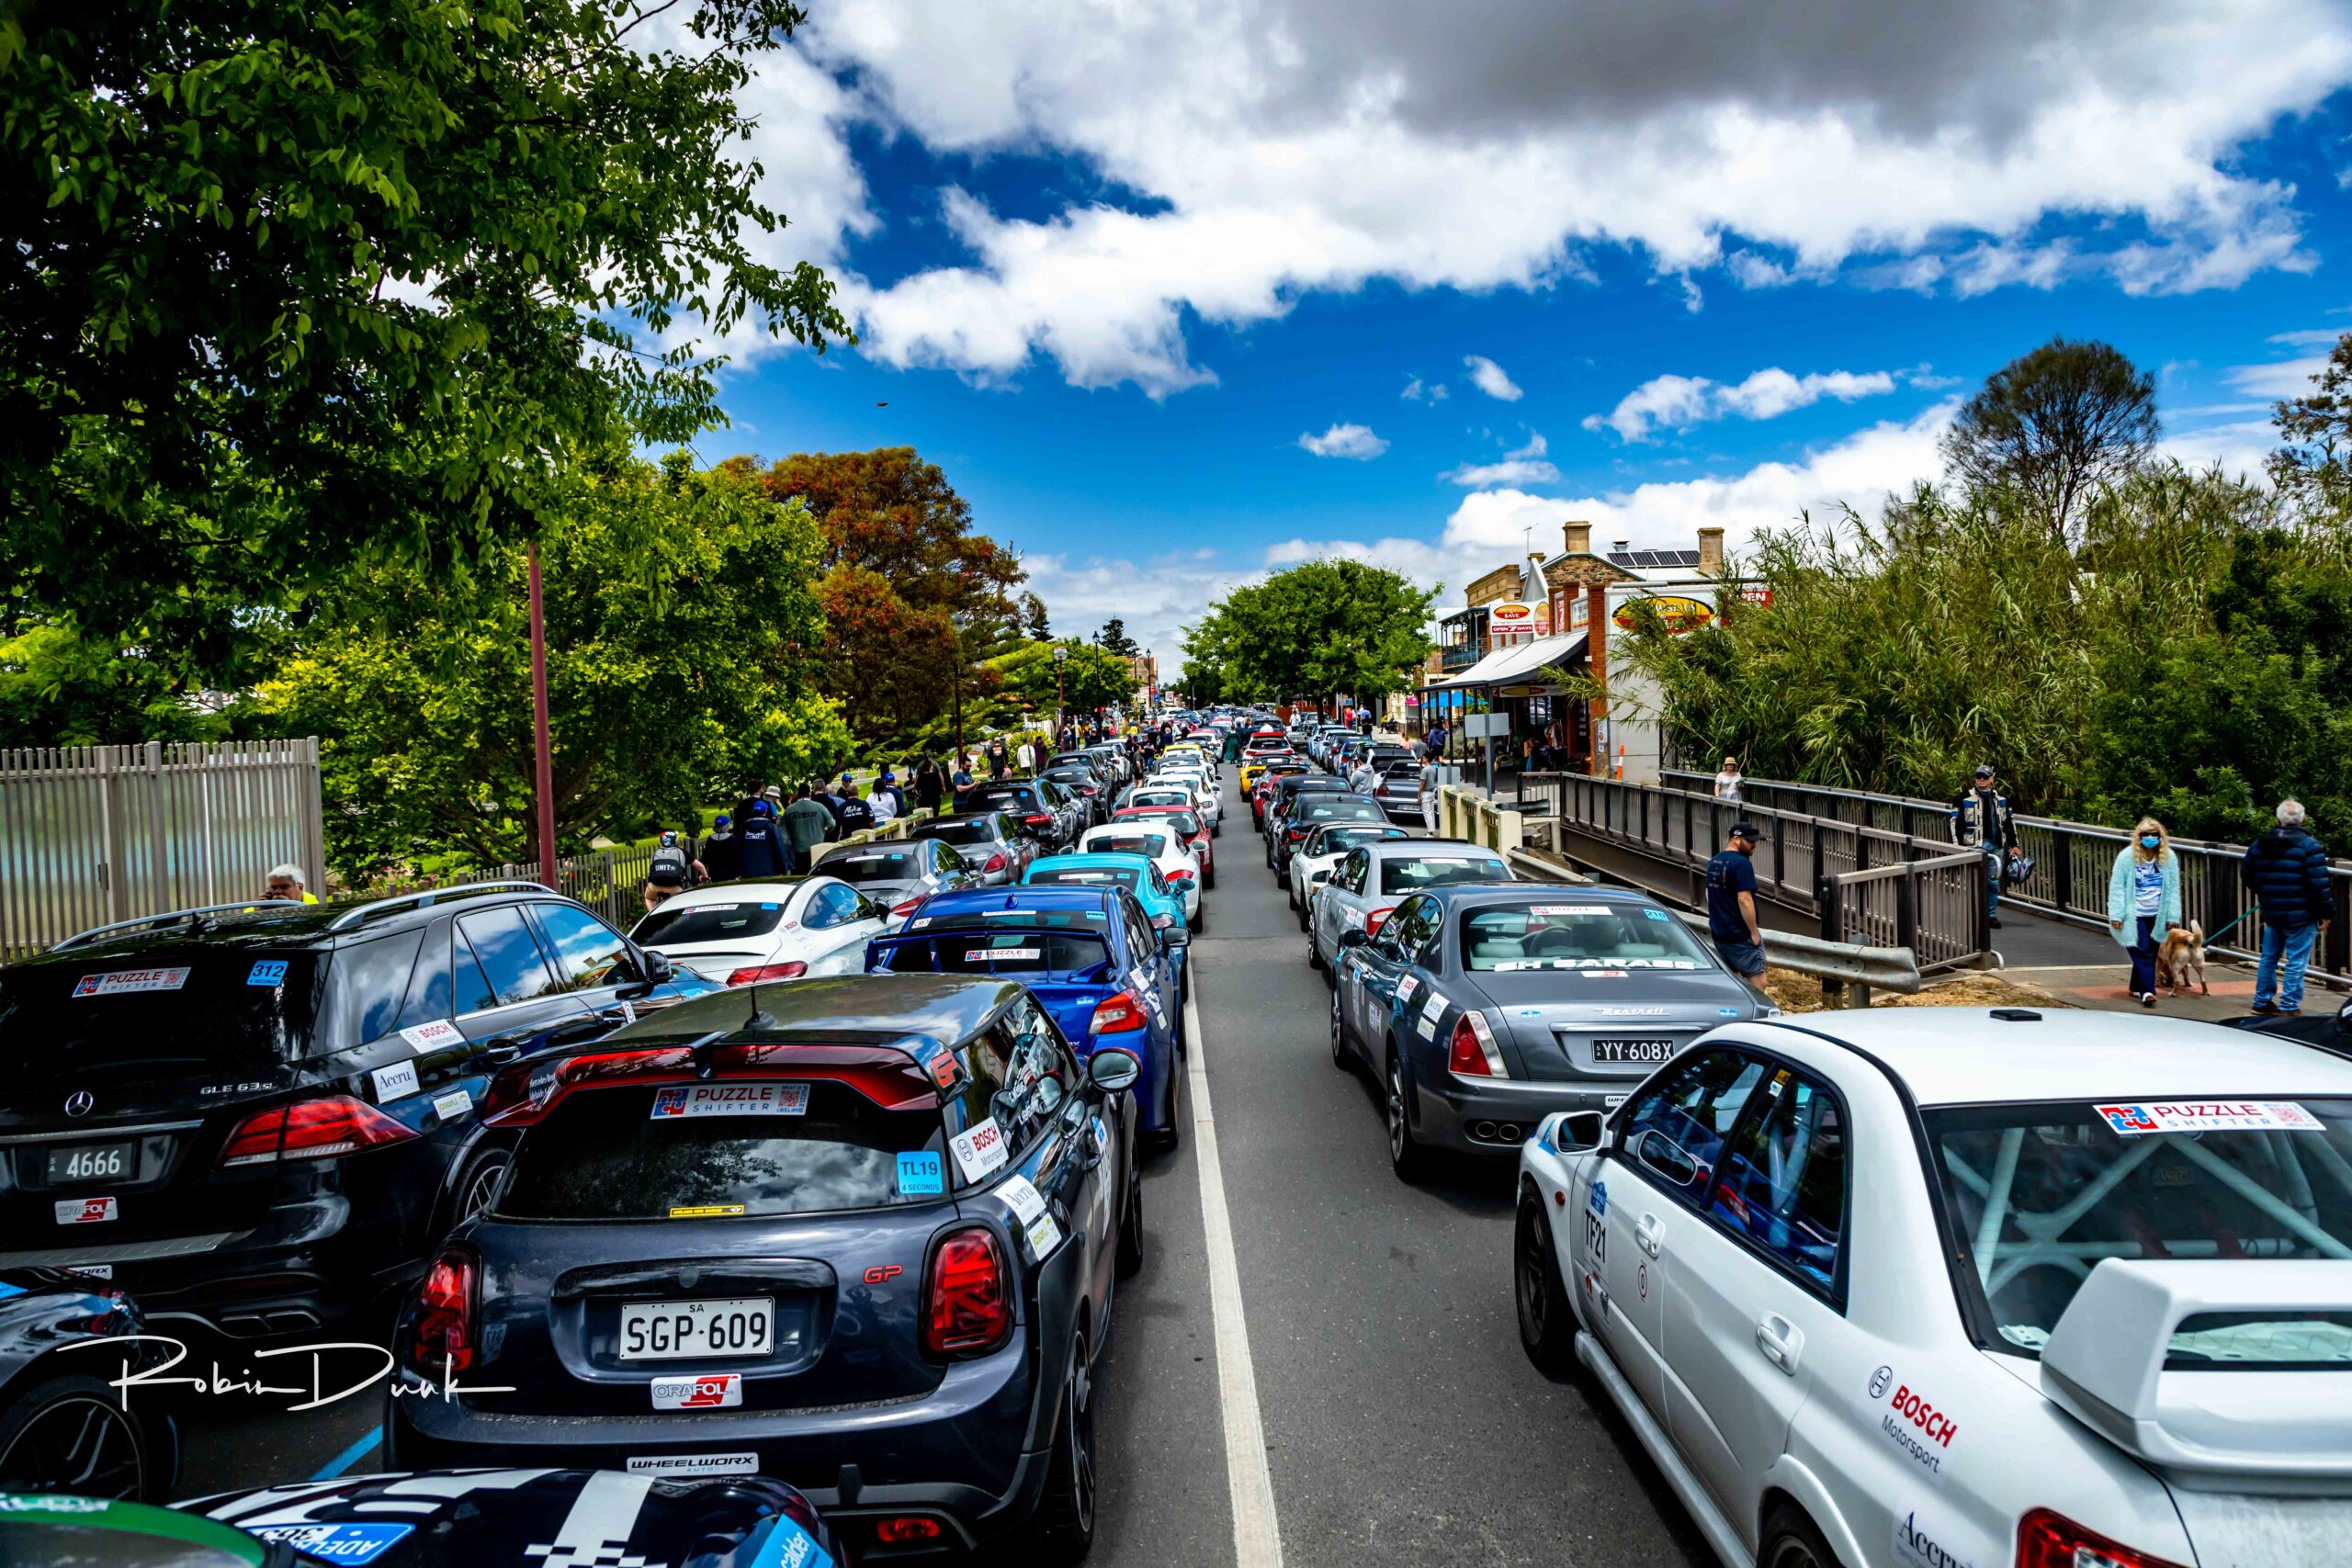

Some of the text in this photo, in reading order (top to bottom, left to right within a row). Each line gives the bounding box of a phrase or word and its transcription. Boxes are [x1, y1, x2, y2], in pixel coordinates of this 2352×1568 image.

[106, 971, 164, 984] PUZZLE
[252, 964, 285, 977] 312
[103, 982, 158, 992] SHIFTER
[419, 1023, 451, 1038] BOSCH
[379, 1070, 413, 1090] Accru
[200, 1085, 233, 1094] GLE
[695, 1087, 774, 1102] PUZZLE
[693, 1102, 770, 1112] SHIFTER
[2153, 1104, 2264, 1118] PUZZLE
[2167, 1118, 2272, 1127] SHIFTER
[972, 1124, 1000, 1152] BOSCH
[66, 1150, 121, 1178] 4666
[900, 1162, 938, 1176] TL19
[908, 1183, 940, 1191] SECONDS
[1585, 1208, 1606, 1264] TF21
[864, 1265, 903, 1284] GP
[689, 1304, 705, 1313] SA
[653, 1382, 729, 1398] ORAFOL
[1891, 1384, 1958, 1449] BOSCH
[1882, 1415, 1940, 1473] Motorsport
[631, 1456, 754, 1469] WHEELWORX
